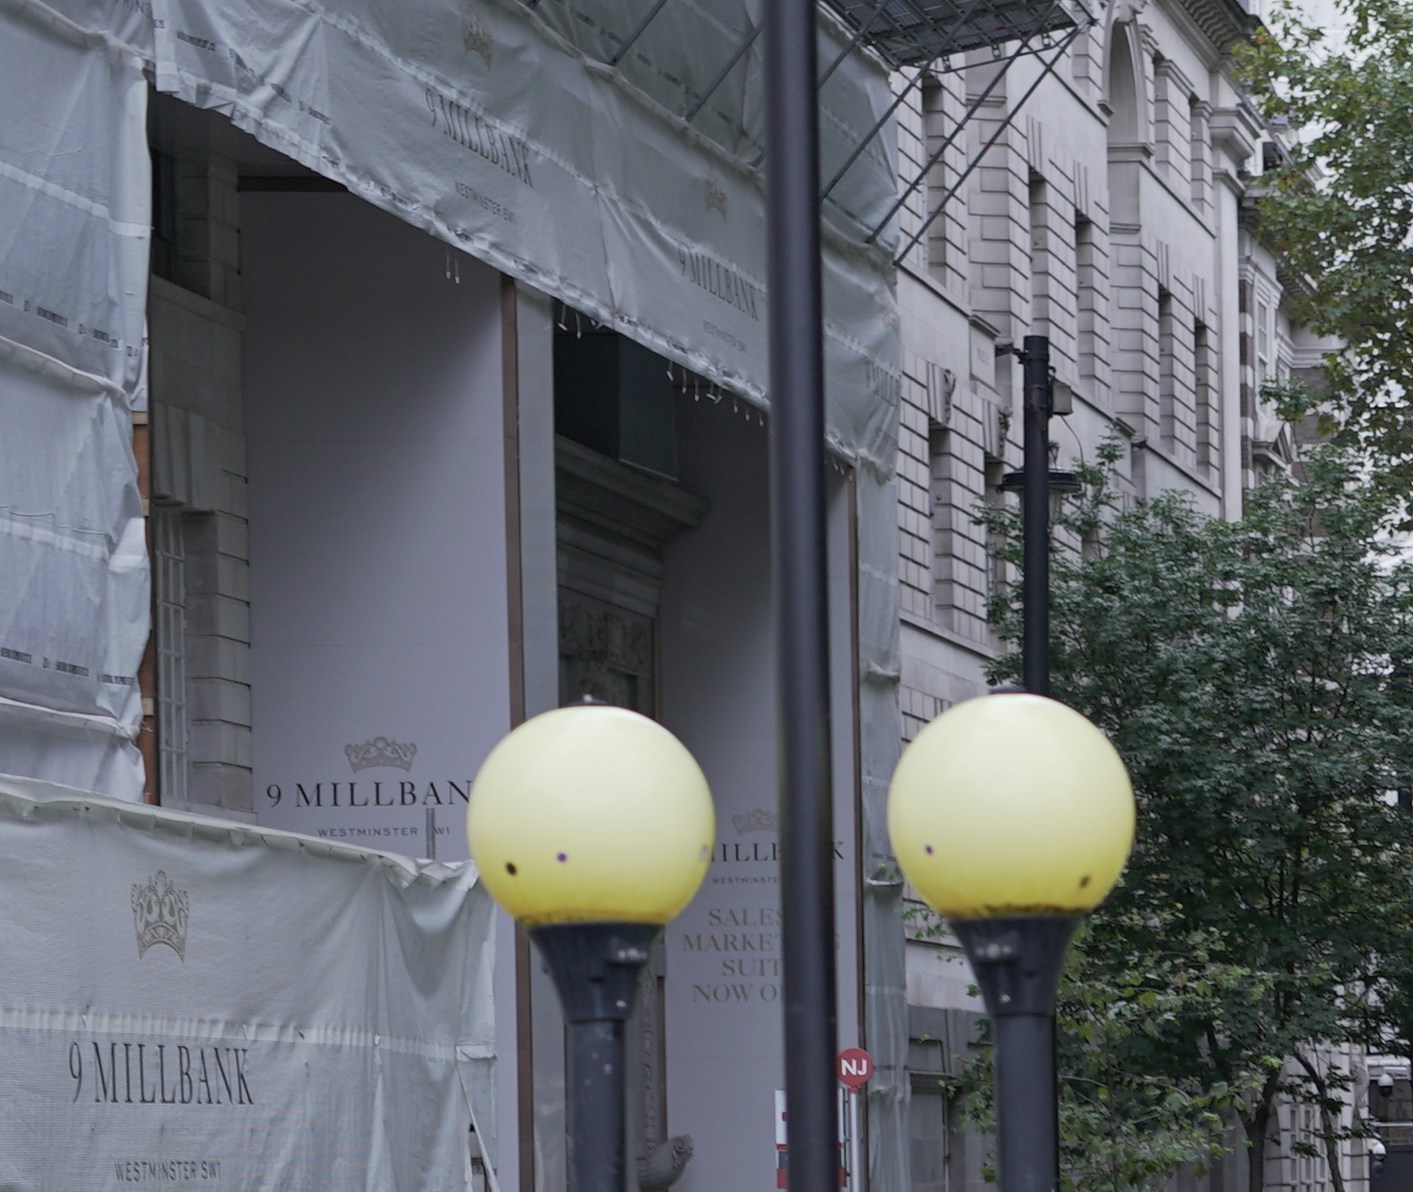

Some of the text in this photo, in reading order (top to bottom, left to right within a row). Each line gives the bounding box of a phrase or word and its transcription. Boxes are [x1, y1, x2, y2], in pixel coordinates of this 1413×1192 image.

[425, 87, 534, 189] 9 MILLBANK
[266, 781, 471, 808] 9 MILLBAN
[317, 827, 418, 838] WESTMINSTER
[722, 959, 782, 977] SUIT
[693, 984, 748, 1003] NOW
[68, 1041, 255, 1105] 9 MILLBANK
[841, 1059, 867, 1076] NJ
[115, 1160, 222, 1182] WESTMINSTER SW1
